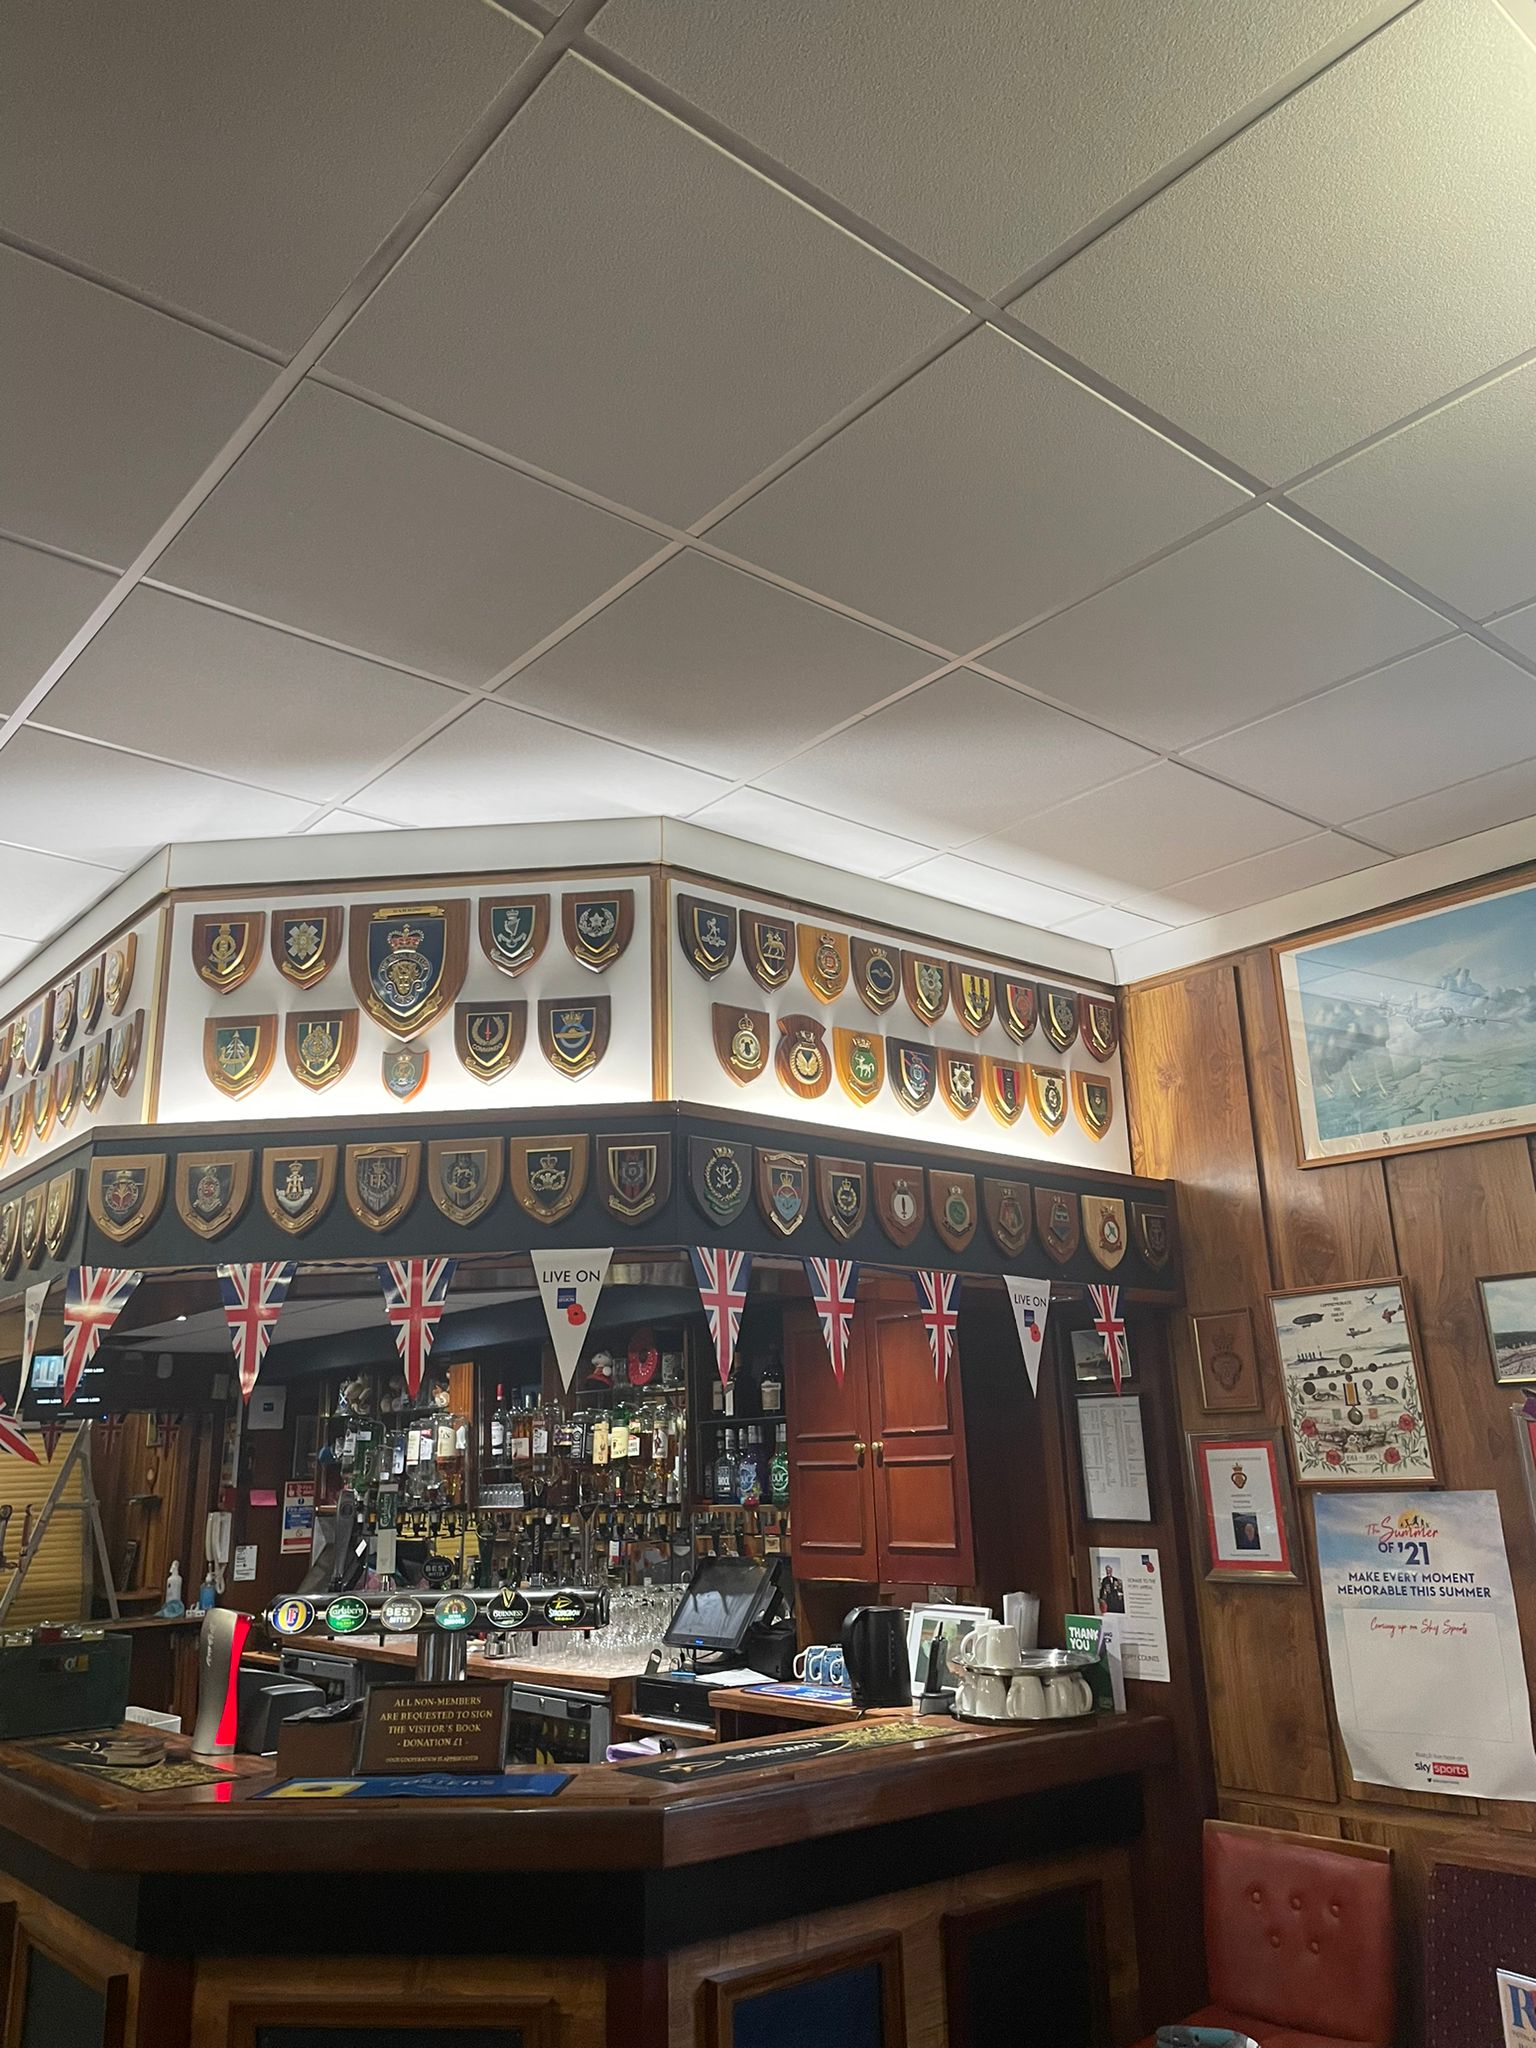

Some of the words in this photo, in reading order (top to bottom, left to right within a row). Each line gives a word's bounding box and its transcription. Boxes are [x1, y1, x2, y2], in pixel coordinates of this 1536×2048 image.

[543, 1270, 571, 1283] LIVE
[576, 1269, 600, 1282] ON
[1014, 1293, 1031, 1306] LIVE
[1033, 1296, 1047, 1307] ON
[1379, 1515, 1439, 1542] Summer
[1378, 1542, 1394, 1553] OF
[425, 1564, 450, 1573] BEST
[1348, 1572, 1380, 1582] MAKE
[1383, 1572, 1418, 1582] EVERY
[1422, 1573, 1475, 1583] MOMENT
[1337, 1585, 1408, 1596] MEMORABLE
[1410, 1586, 1436, 1596] THIS
[1439, 1586, 1491, 1598] SUMMER
[329, 1604, 364, 1617] Carlsberg
[386, 1607, 417, 1616] BEST
[492, 1609, 524, 1617] GUINNESS
[389, 1616, 411, 1624] BITTER
[1068, 1627, 1099, 1640] THANK
[1070, 1639, 1090, 1651] YOU
[394, 1699, 412, 1707] ALL
[414, 1696, 482, 1707] NON-MEMBERS
[380, 1712, 399, 1721] ARE
[400, 1711, 455, 1721] REQUESTED
[457, 1711, 470, 1719] TO
[470, 1710, 493, 1719] SIGN
[388, 1725, 406, 1734] THE
[409, 1724, 453, 1734] VISITOR'S
[456, 1723, 481, 1732] BOOK
[403, 1738, 452, 1747] DONATION
[1414, 1761, 1431, 1773] sky
[1433, 1765, 1467, 1775] sports
